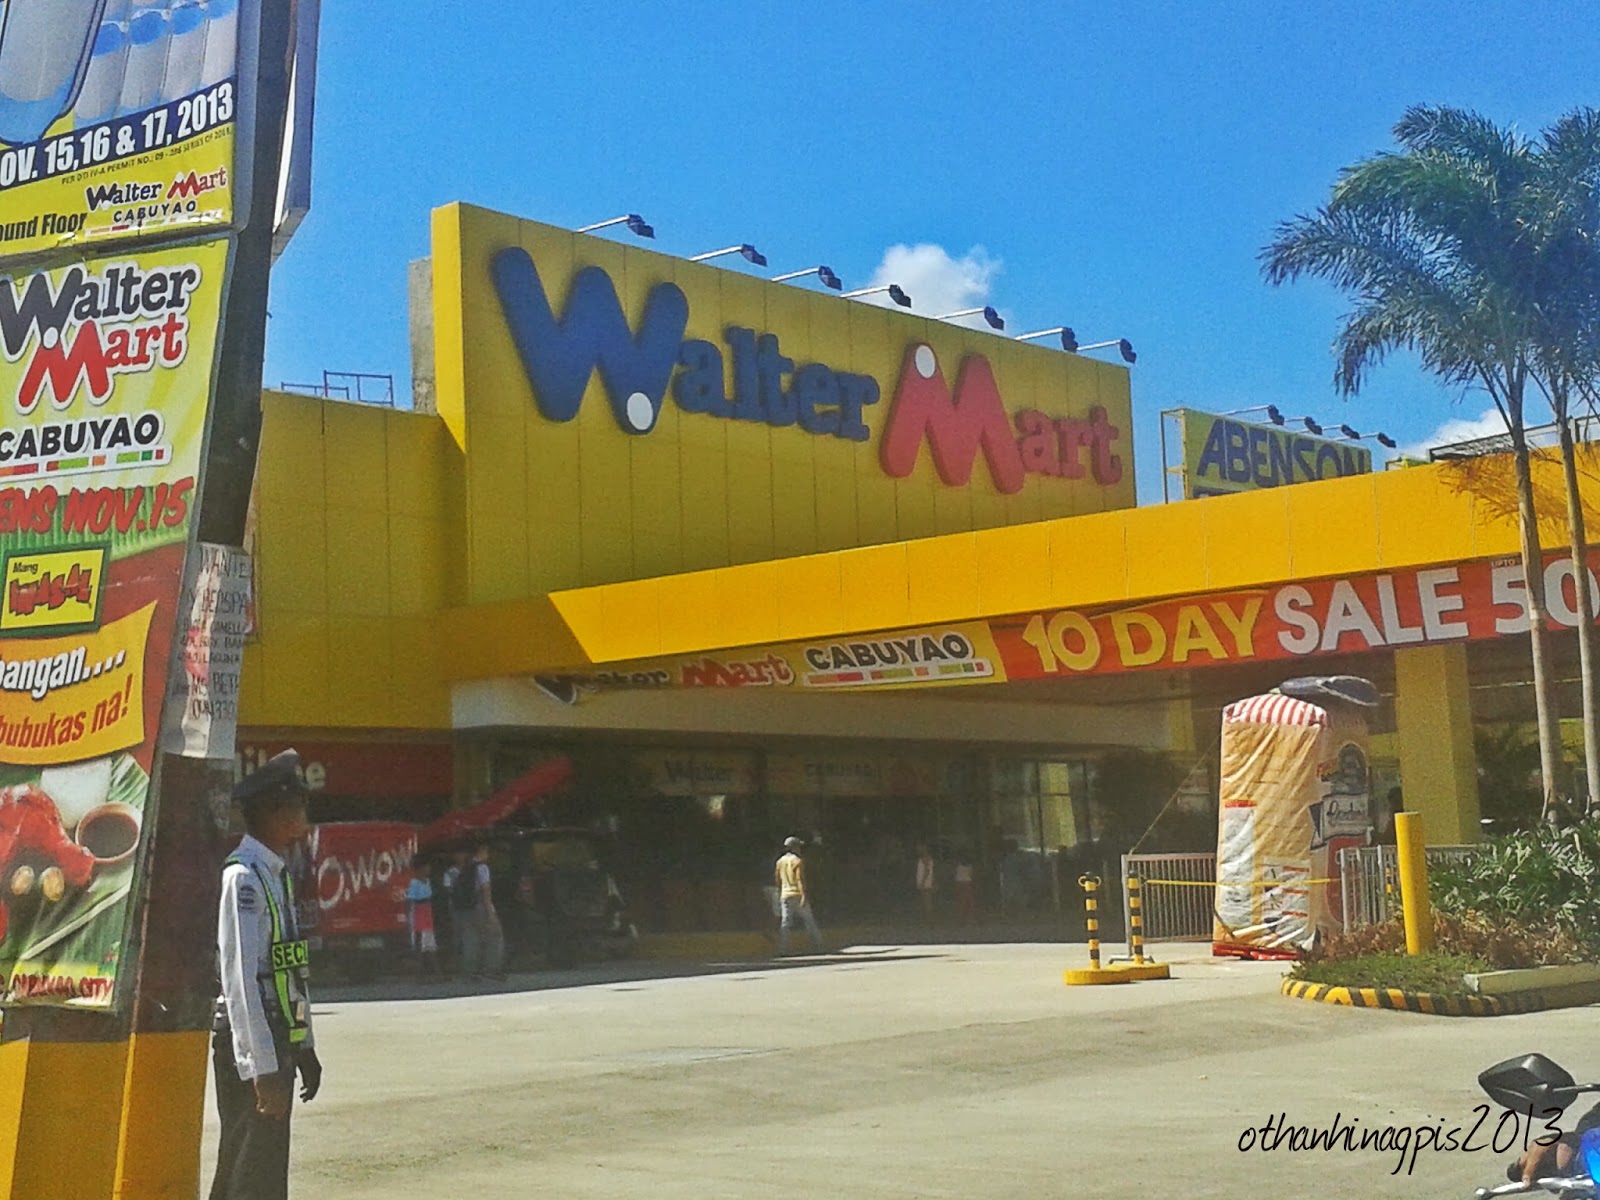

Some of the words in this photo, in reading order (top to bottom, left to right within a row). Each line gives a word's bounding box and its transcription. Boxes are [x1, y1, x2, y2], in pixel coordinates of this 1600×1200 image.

[116, 125, 136, 156] &
[142, 109, 172, 147] 17,
[177, 82, 234, 135] 2013
[86, 182, 162, 211] Walter
[166, 167, 227, 200] Mart
[106, 159, 136, 173] PERMIT
[0, 215, 38, 242] und
[42, 211, 87, 234] Floor
[113, 200, 197, 223] CABUYAO
[0, 266, 197, 357] Walter
[18, 311, 185, 408] Mart
[490, 246, 879, 441] Walter
[879, 342, 1123, 495] Mart
[0, 413, 160, 462] CABUYAO
[1022, 610, 1101, 673] 10
[1110, 597, 1264, 667] DAY
[1274, 566, 1470, 655] SALE
[1491, 557, 1600, 635] 50
[681, 652, 793, 688] Mart
[805, 633, 970, 671] CABUYAO
[91, 672, 133, 735] na!
